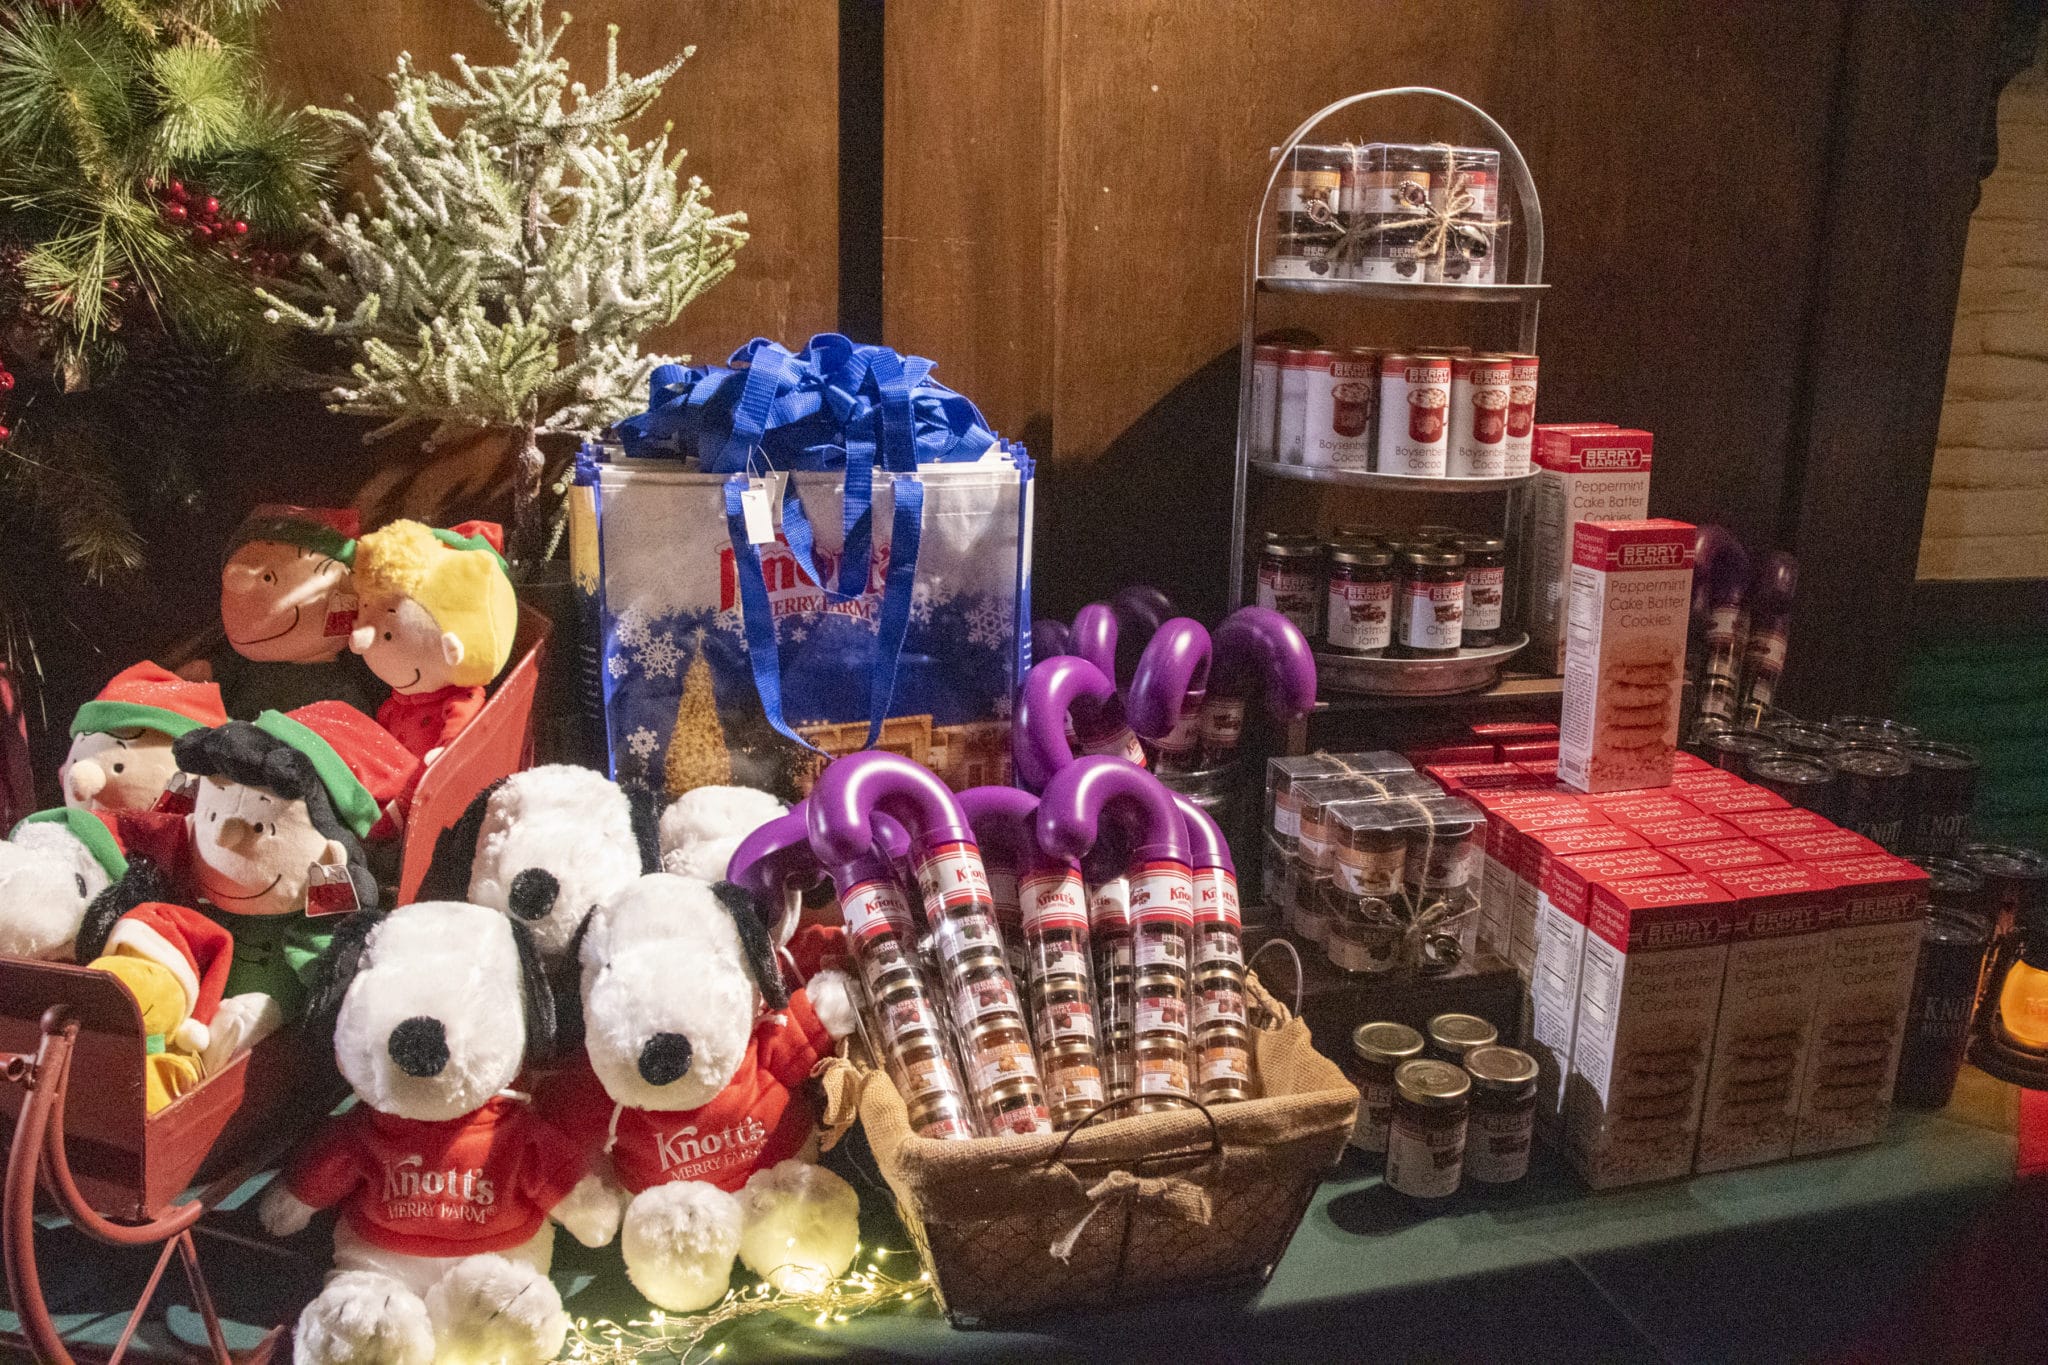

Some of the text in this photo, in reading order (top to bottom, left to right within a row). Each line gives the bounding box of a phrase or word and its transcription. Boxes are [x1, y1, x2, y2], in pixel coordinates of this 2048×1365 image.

[1409, 368, 1449, 377] BERRY
[1409, 376, 1449, 384] MARKET
[1585, 450, 1637, 460] BERRY
[1585, 459, 1637, 468] MARKET
[1574, 480, 1645, 493] Peppermint
[1573, 495, 1643, 509] Cake Batter
[1583, 511, 1633, 521] Cookies
[1623, 545, 1679, 557] BERRY
[1623, 556, 1678, 565] MARKET
[1348, 587, 1389, 595] BERRY
[1610, 579, 1686, 595] Peppermint
[772, 597, 818, 617] ERRY
[1608, 597, 1685, 611] Cake Batter
[1620, 614, 1672, 629] Cookies
[1356, 636, 1380, 646] Jam
[1500, 795, 1556, 805] Cookies
[1626, 808, 1682, 819] Cookies
[1531, 815, 1590, 827] Cookies
[1666, 829, 1723, 841] Cookies
[1567, 838, 1628, 849] Cookies
[1803, 844, 1862, 856] Cookies
[1575, 853, 1662, 870] Cake Batter
[1704, 854, 1764, 867] Cookies
[1600, 863, 1662, 877] Cookies
[1845, 869, 1908, 881] Cookies
[1605, 875, 1698, 888] Peppermint
[1722, 869, 1810, 886] Cake Batter
[1617, 880, 1710, 896] Cake Batter
[1748, 880, 1811, 893] Cookies
[1643, 891, 1710, 904] Cookies
[652, 1115, 766, 1174] Knott's
[670, 1157, 722, 1182] MERRY
[381, 1154, 495, 1206] Knott's
[387, 1201, 437, 1220] MERRY
